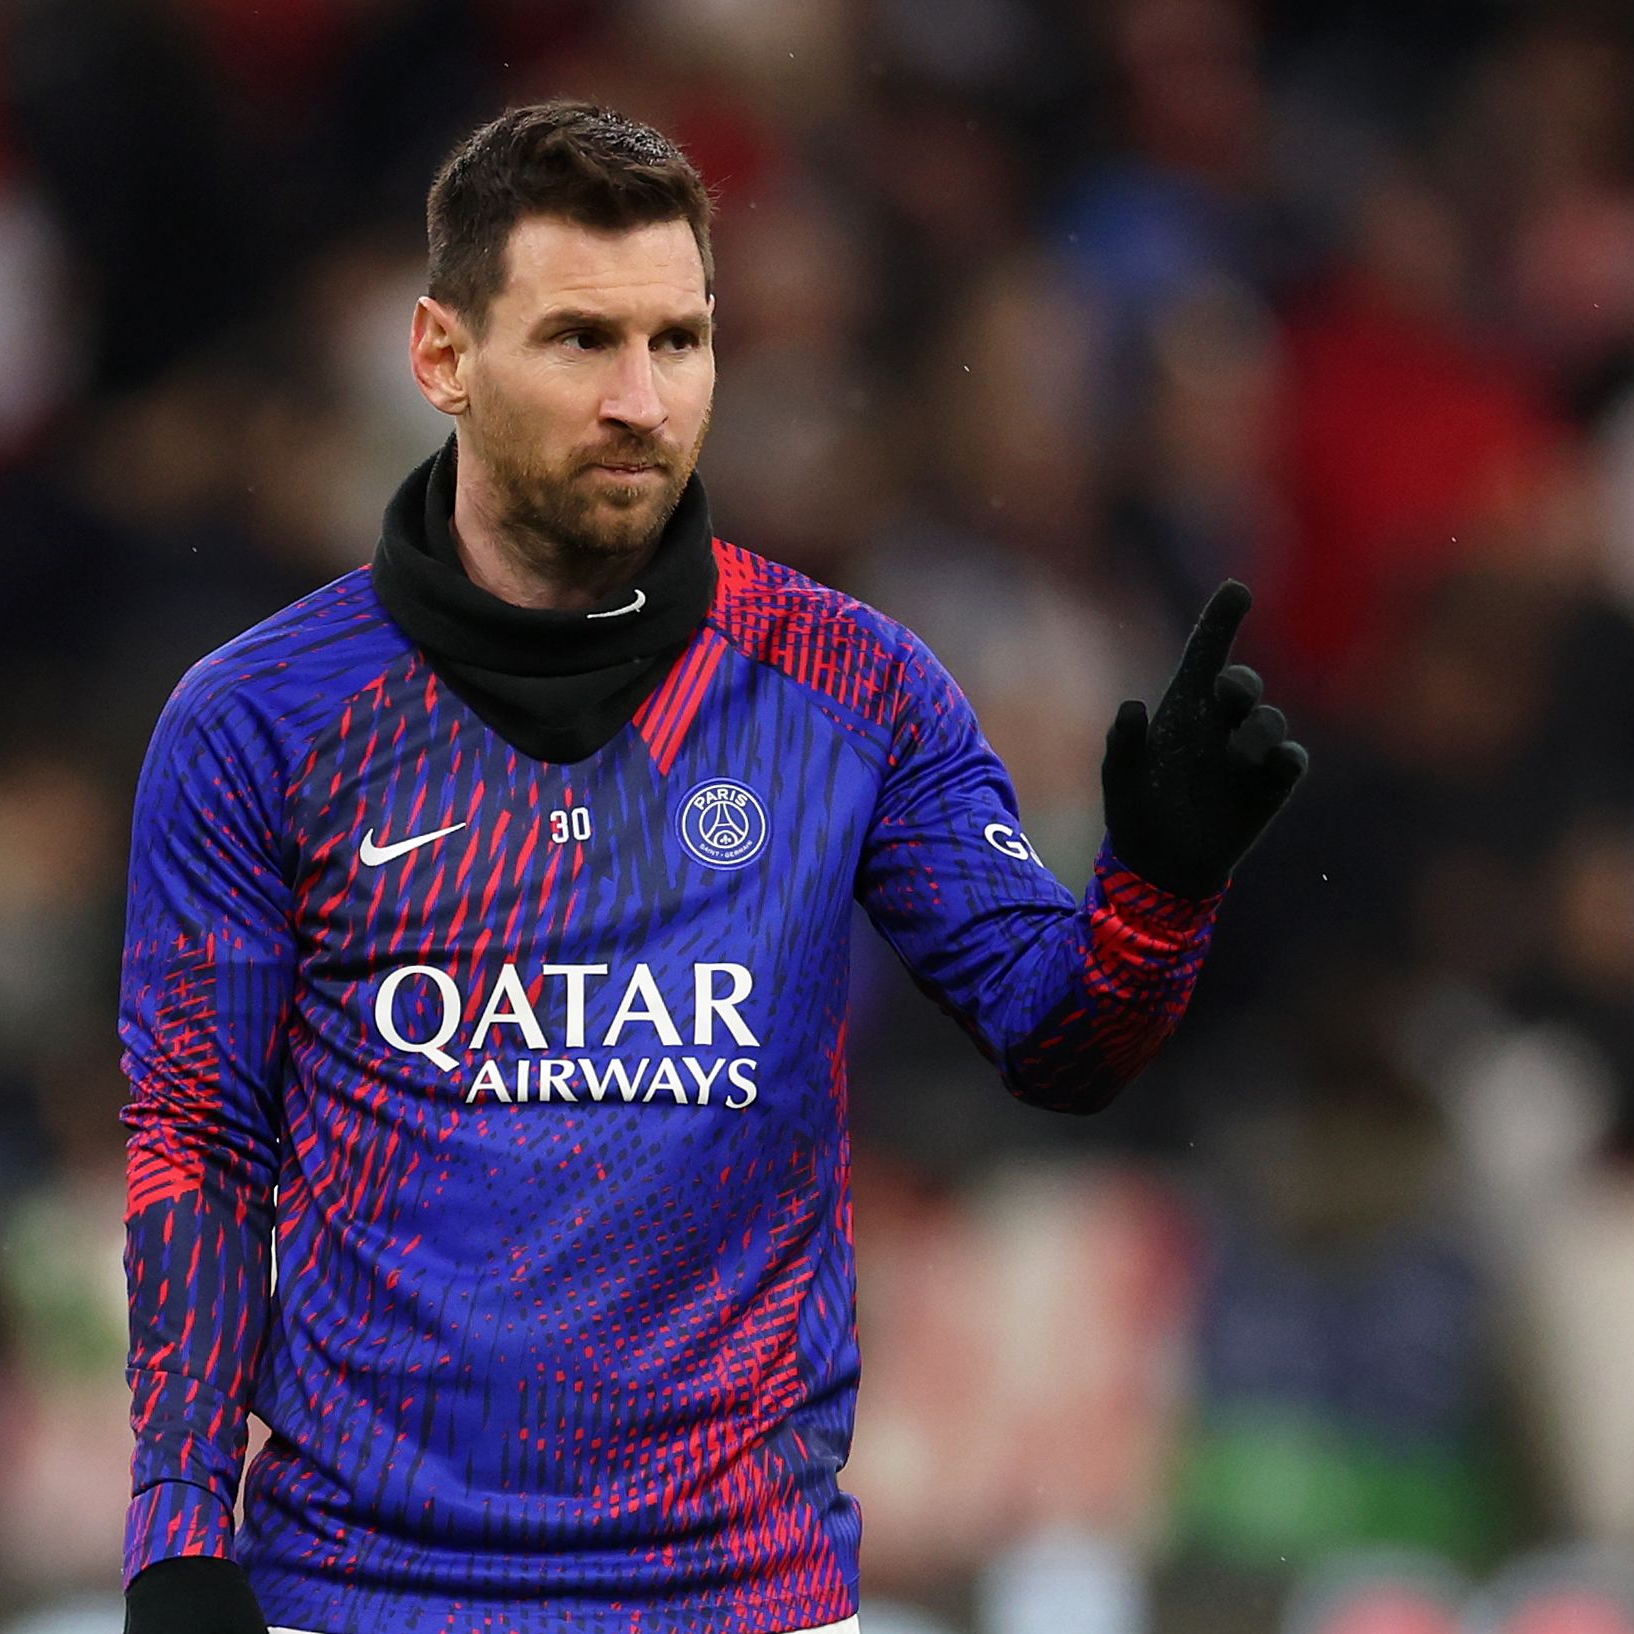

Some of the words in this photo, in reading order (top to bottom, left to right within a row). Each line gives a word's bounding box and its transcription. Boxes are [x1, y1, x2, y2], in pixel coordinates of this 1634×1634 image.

[693, 788, 748, 811] PARIS
[550, 807, 591, 843] 30
[374, 962, 761, 1071] QATAR
[466, 1057, 757, 1108] AIRWAYS
